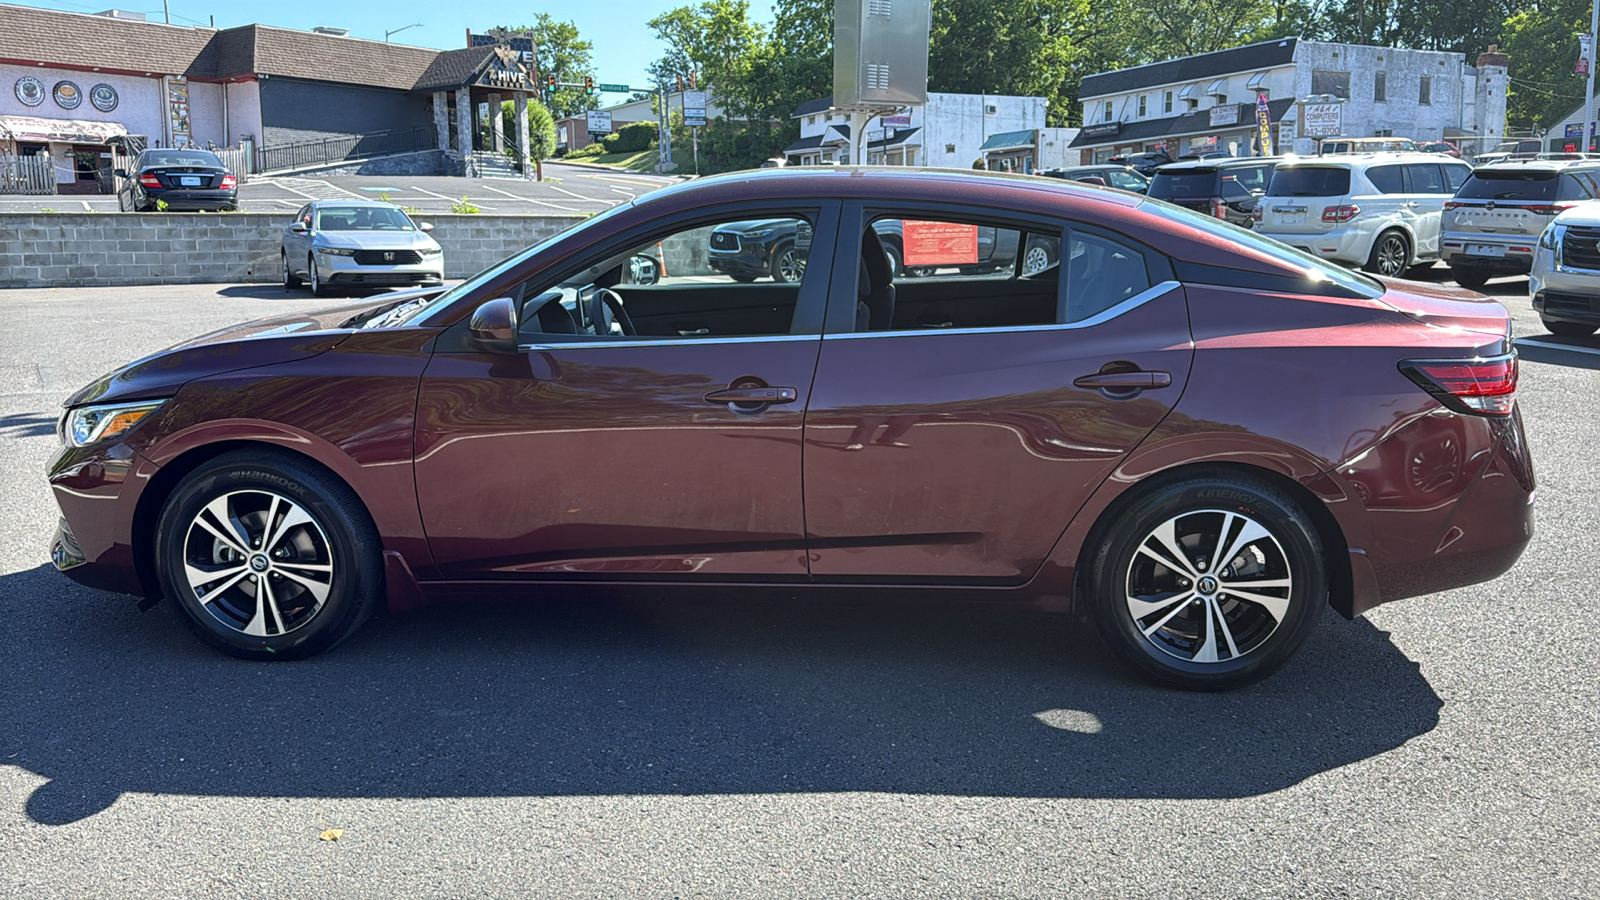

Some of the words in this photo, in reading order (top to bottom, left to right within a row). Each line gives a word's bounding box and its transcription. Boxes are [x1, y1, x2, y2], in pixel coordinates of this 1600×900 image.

[498, 70, 526, 83] HIVE
[601, 84, 621, 92] Woodland
[1306, 112, 1339, 121] COMPUTERS
[1304, 127, 1340, 136] 942-9700
[1455, 211, 1528, 219] PATHFINDER
